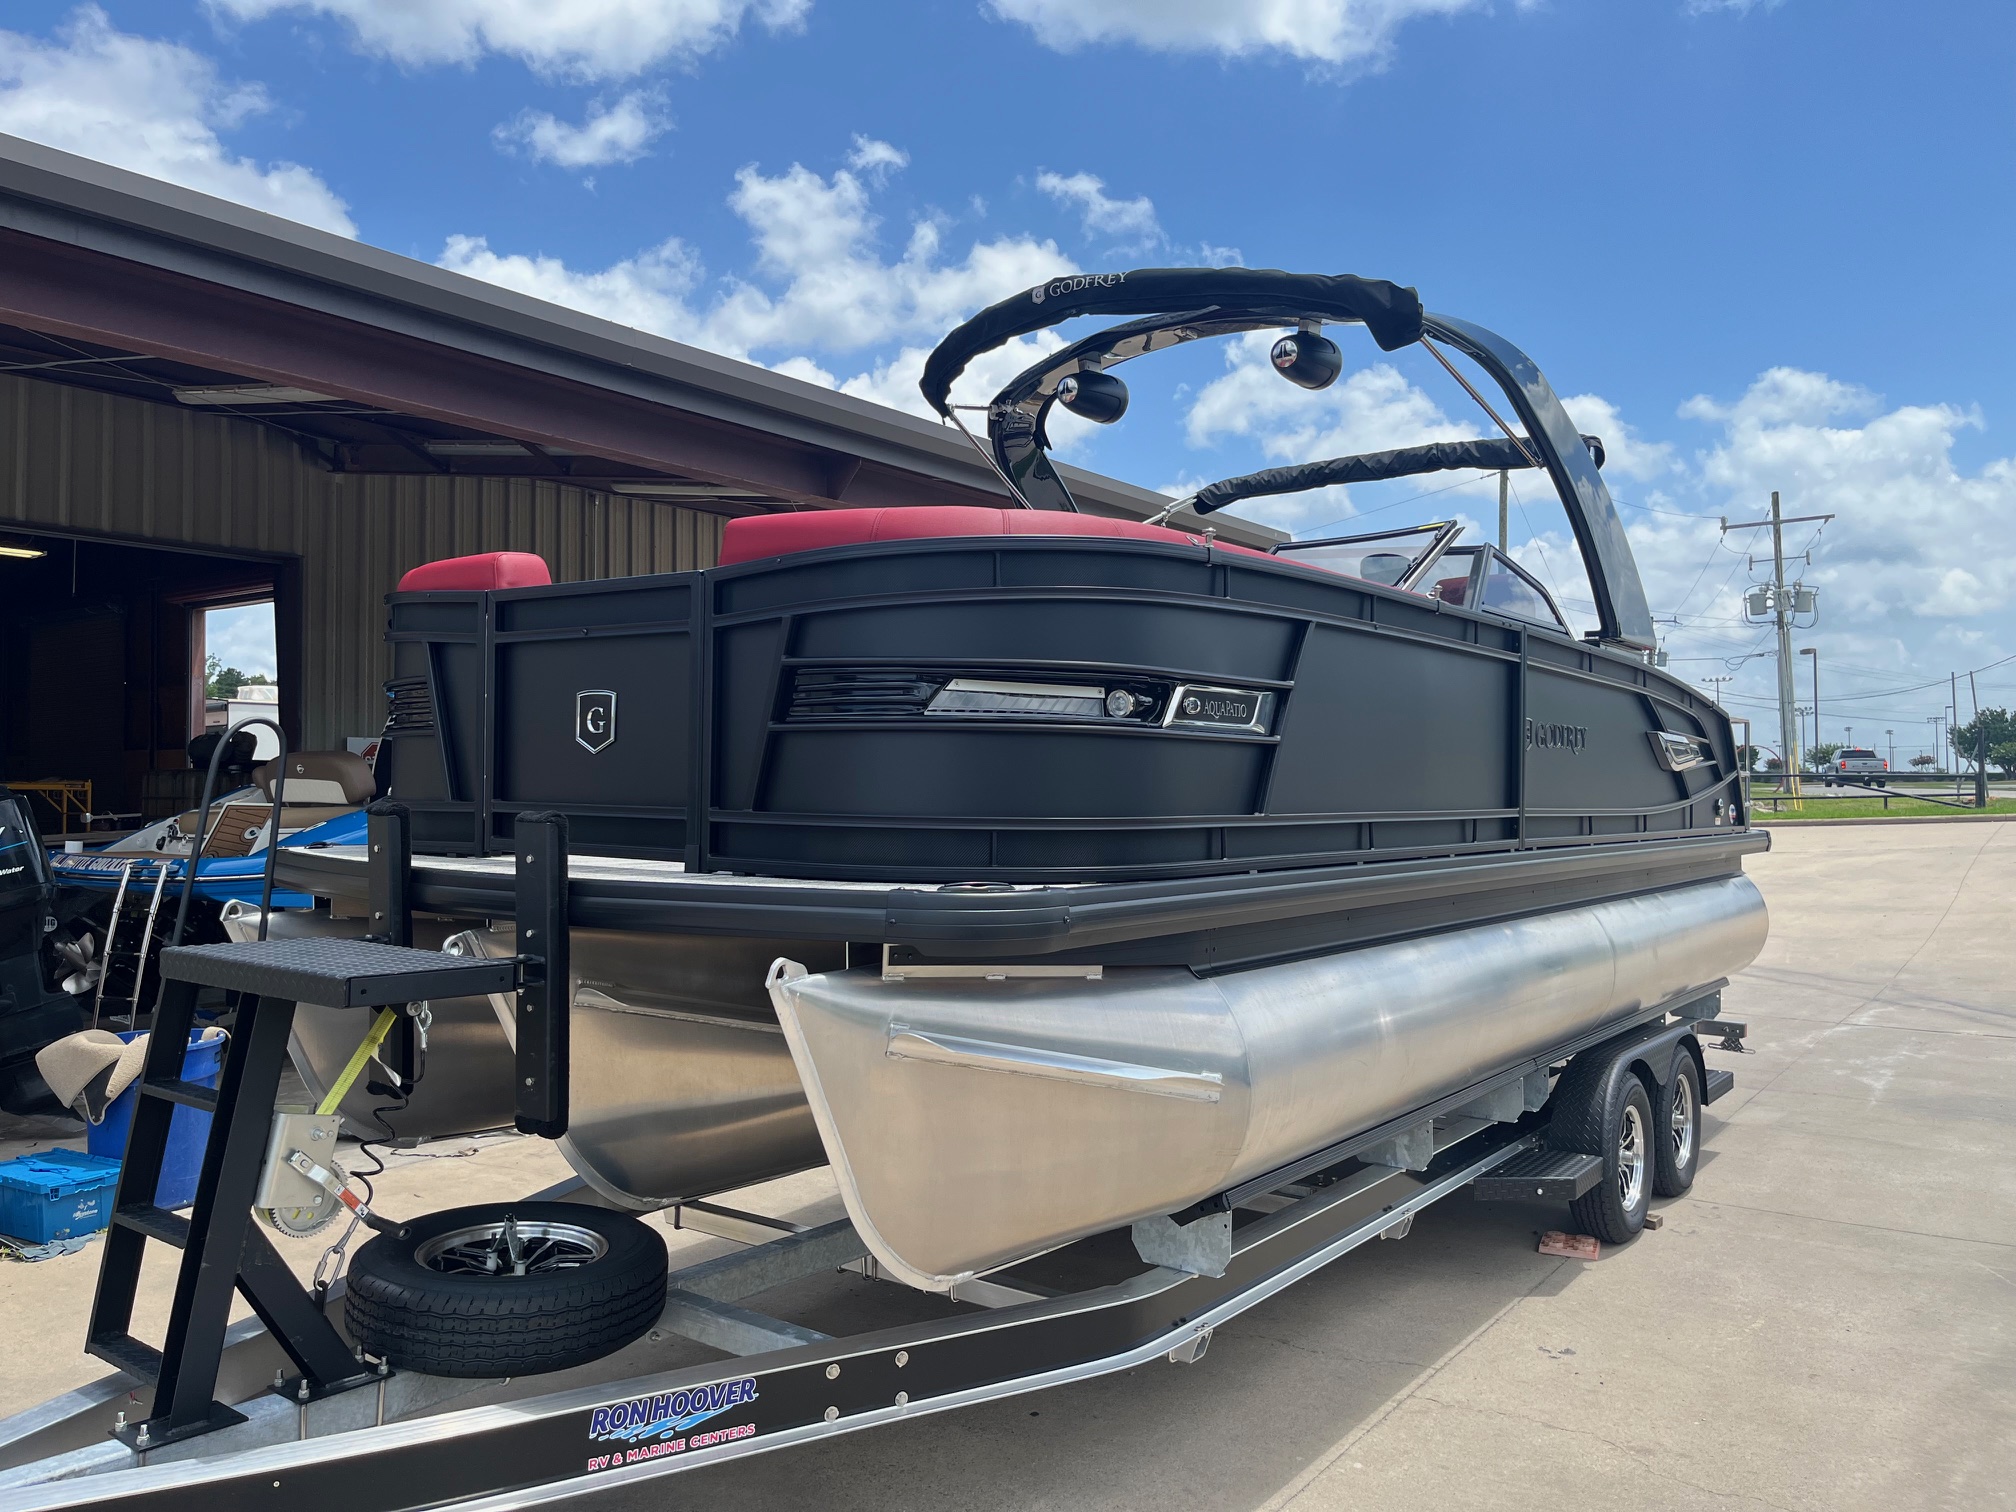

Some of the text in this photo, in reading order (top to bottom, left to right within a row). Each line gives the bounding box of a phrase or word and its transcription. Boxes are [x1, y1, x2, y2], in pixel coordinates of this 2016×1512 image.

[1049, 272, 1129, 297] GODFREY
[586, 706, 607, 734] G
[590, 1377, 757, 1436] RON HOOVER
[588, 1423, 757, 1471] RV & MARINE CENTERS
